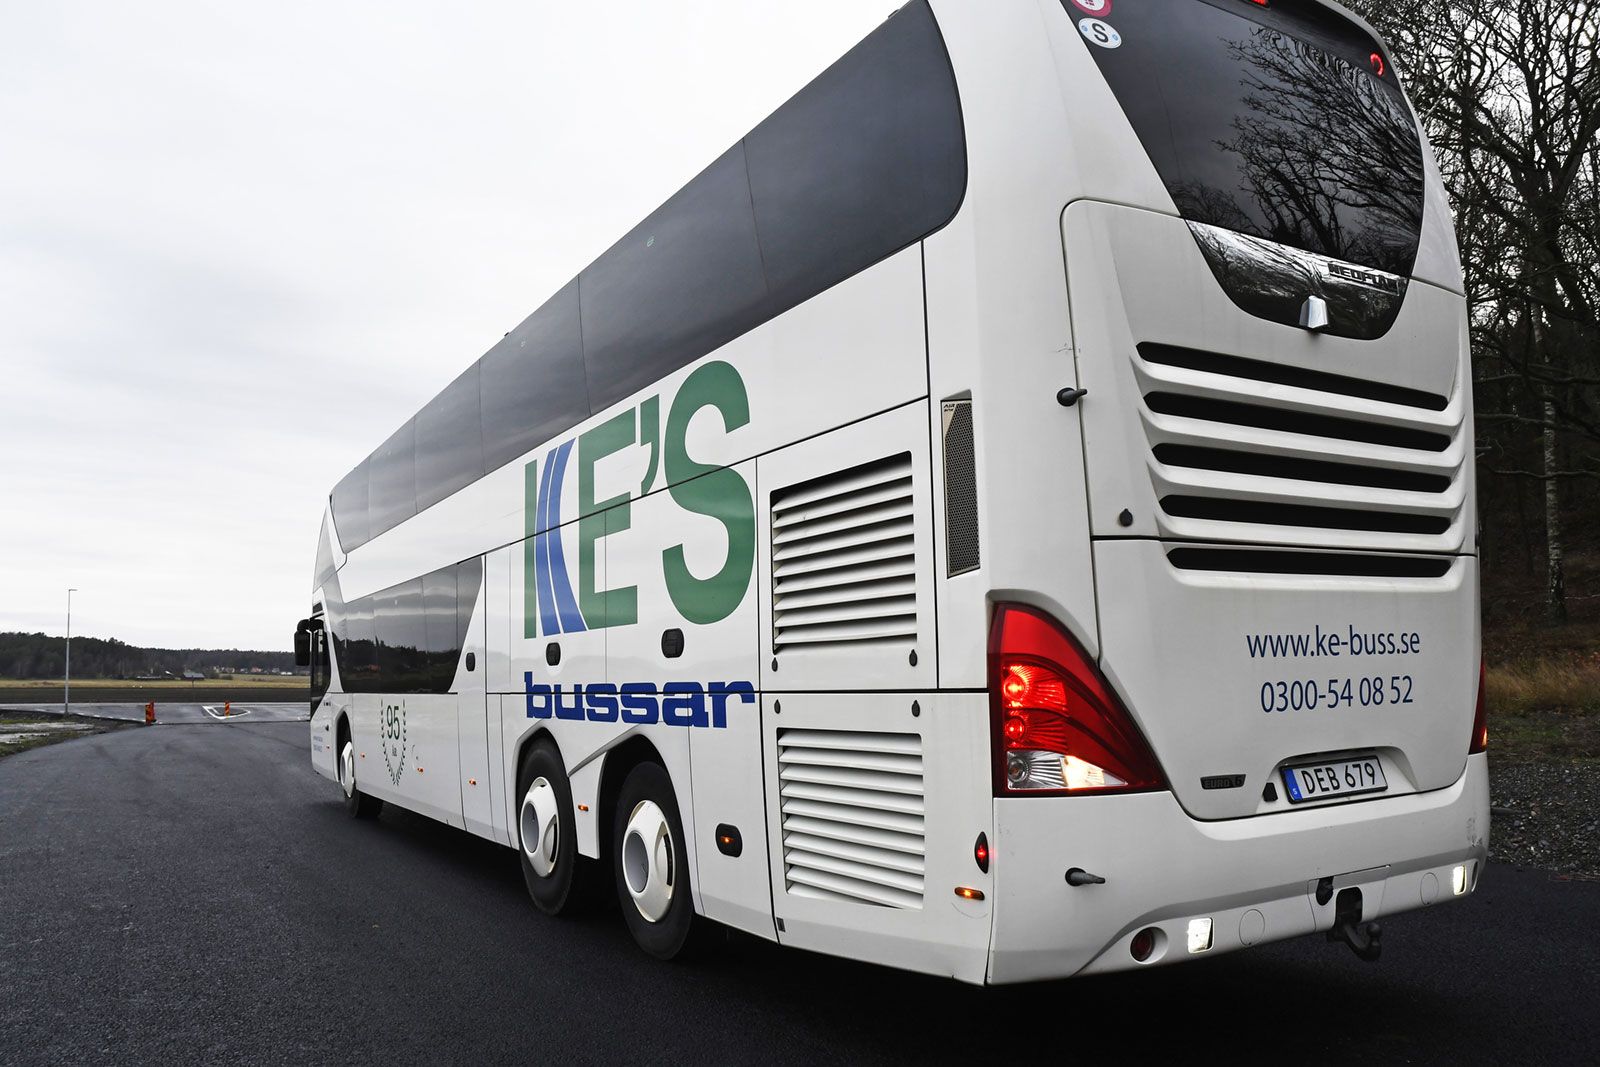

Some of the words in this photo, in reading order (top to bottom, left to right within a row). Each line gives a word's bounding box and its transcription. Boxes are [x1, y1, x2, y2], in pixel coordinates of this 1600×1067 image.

[1091, 22, 1109, 43] S
[1246, 624, 1420, 658] www.ke-buss.se
[524, 671, 755, 728] bussar
[1260, 678, 1353, 713] 0300-54
[1359, 677, 1384, 707] 08
[1390, 675, 1413, 704] 52
[386, 704, 400, 740] 95
[1300, 766, 1340, 795] DEB
[1345, 762, 1376, 788] 679
